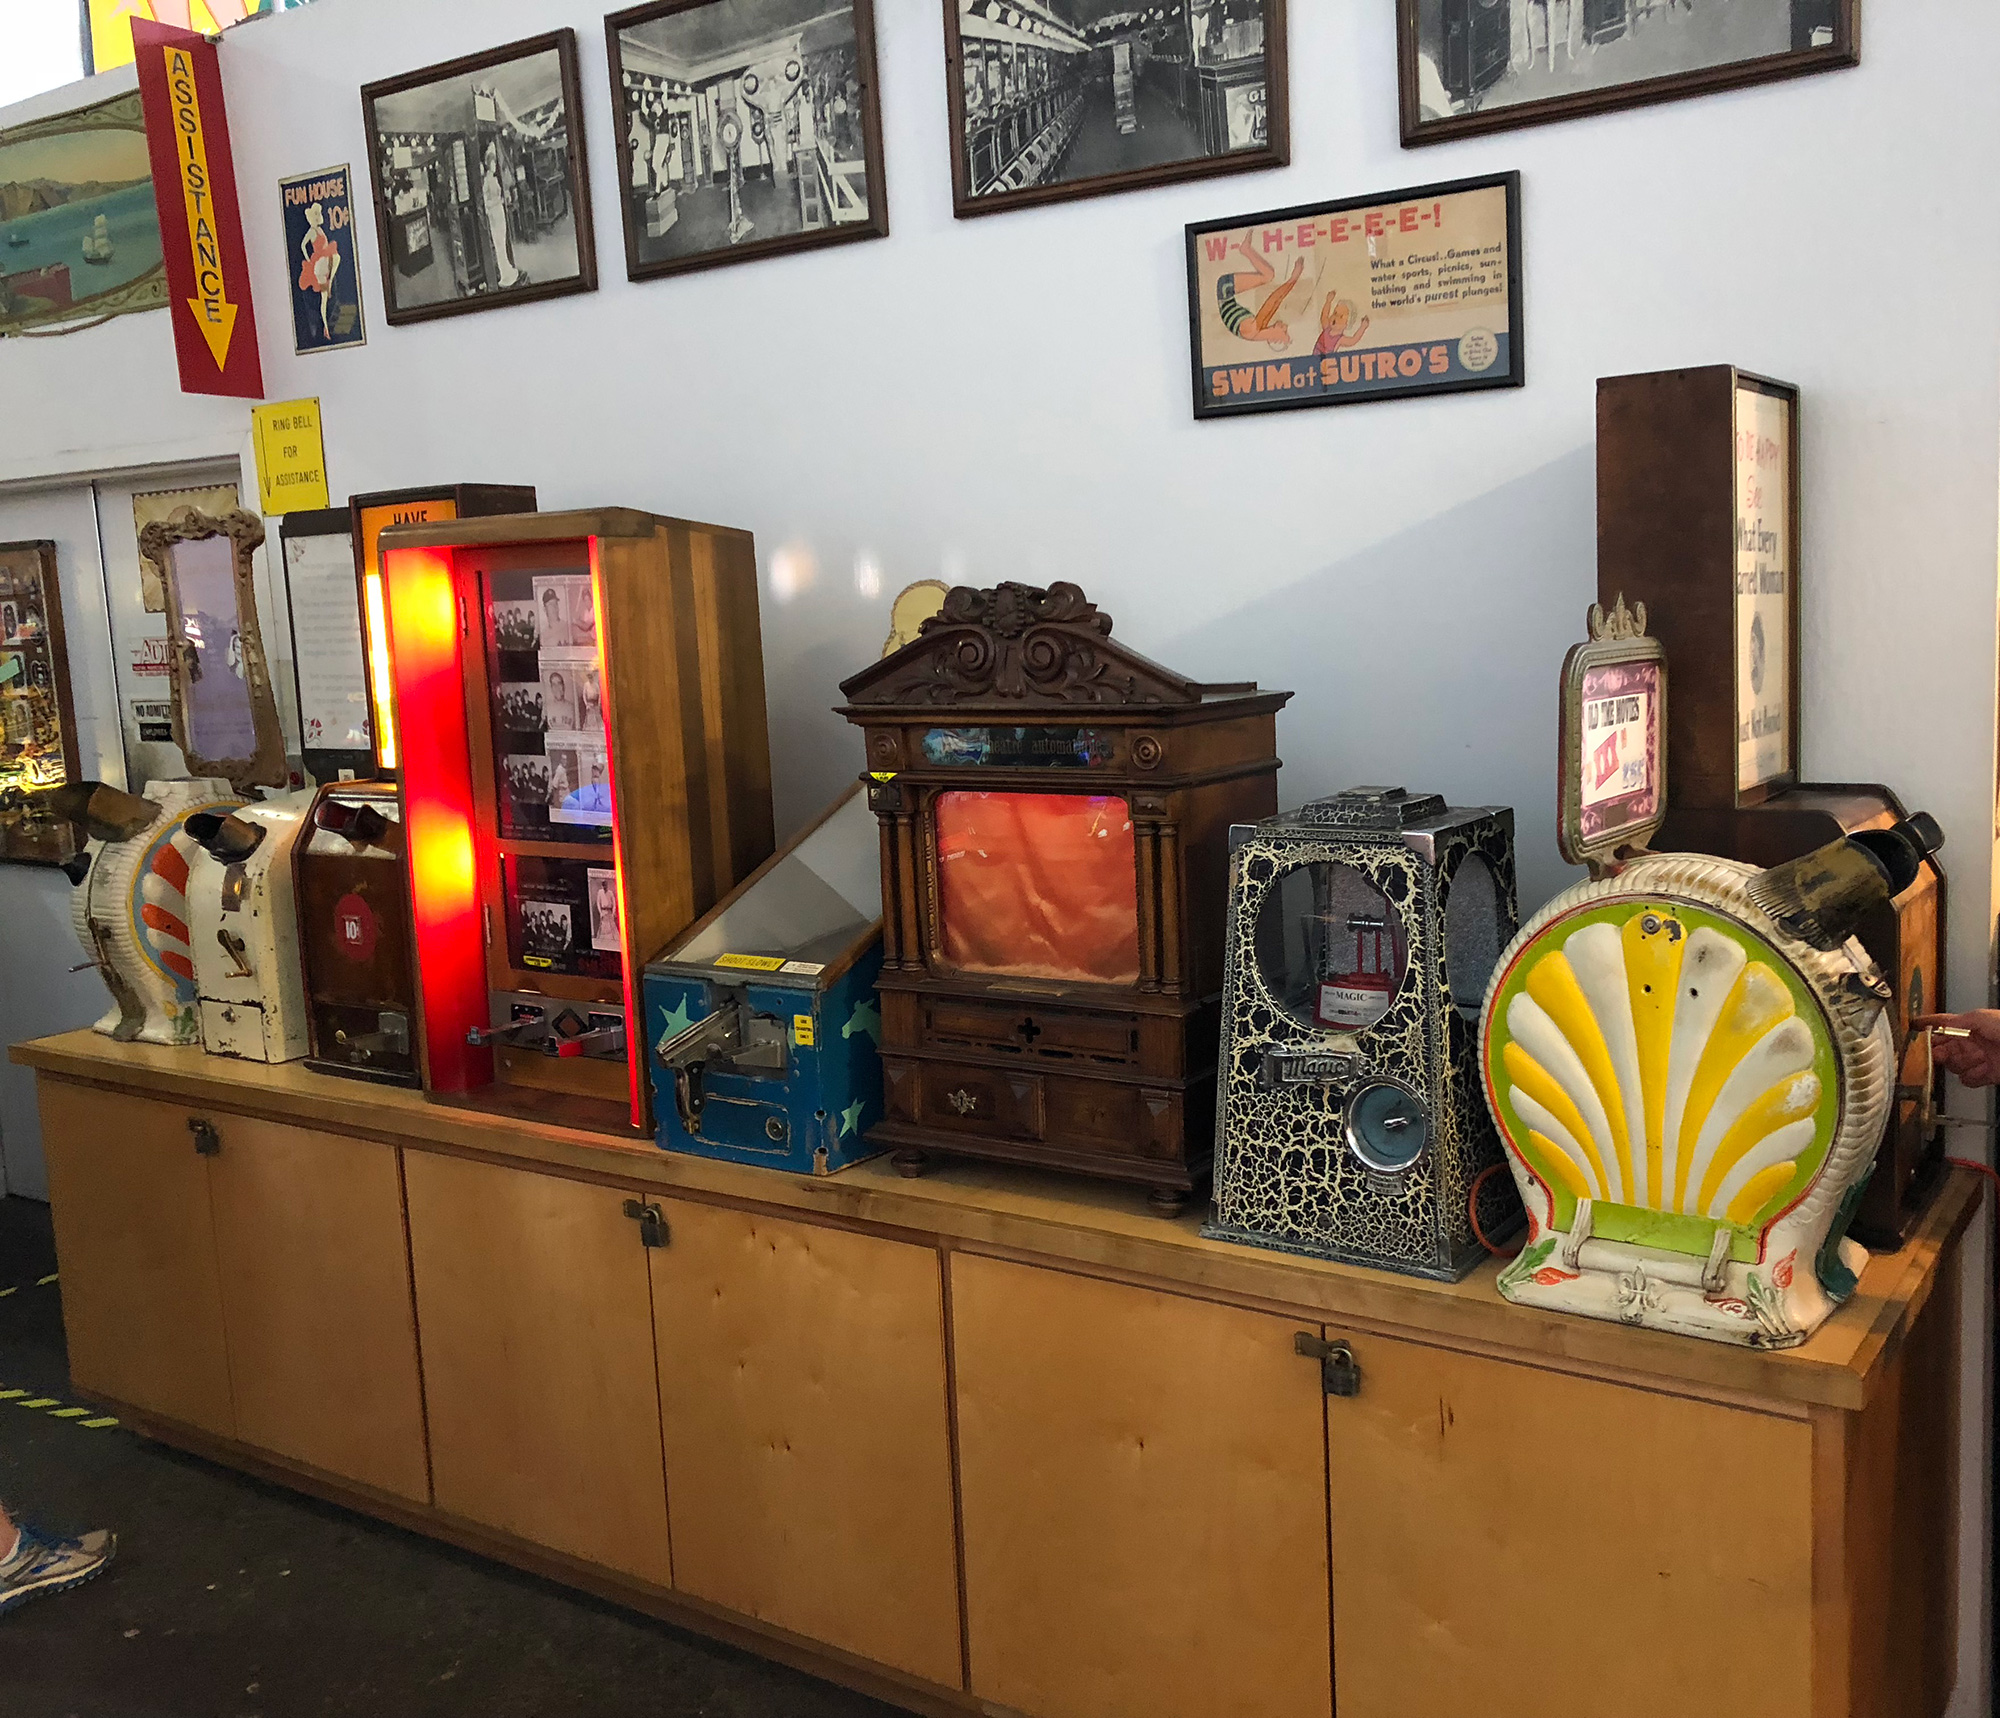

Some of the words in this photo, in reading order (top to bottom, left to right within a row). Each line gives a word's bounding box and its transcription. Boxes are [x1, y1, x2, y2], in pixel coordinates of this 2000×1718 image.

[171, 52, 222, 323] ASSISTANCE
[285, 186, 307, 207] FUN
[308, 177, 345, 202] HOUSE
[1370, 259, 1395, 270] What
[1483, 242, 1502, 254] and
[1371, 273, 1396, 283] water
[1401, 267, 1433, 280] sports,
[1438, 262, 1473, 276] picnics,
[1371, 283, 1406, 296] bathing
[1413, 279, 1431, 291] and
[1437, 274, 1486, 287] swimming
[1493, 270, 1503, 280] in
[1371, 299, 1387, 309] the
[1389, 294, 1422, 306] world's
[1424, 288, 1459, 303] purest
[1462, 282, 1503, 299] plunges!
[1212, 363, 1292, 397] SWIM
[1293, 366, 1317, 388] at
[1320, 345, 1449, 386] SUTRO'S
[272, 418, 291, 431] RING
[292, 415, 313, 430] BELL
[283, 446, 298, 458] FOR
[275, 470, 319, 487] ASSISTANCE
[393, 510, 428, 525] HAVE
[1335, 990, 1368, 1002] MAGIC
